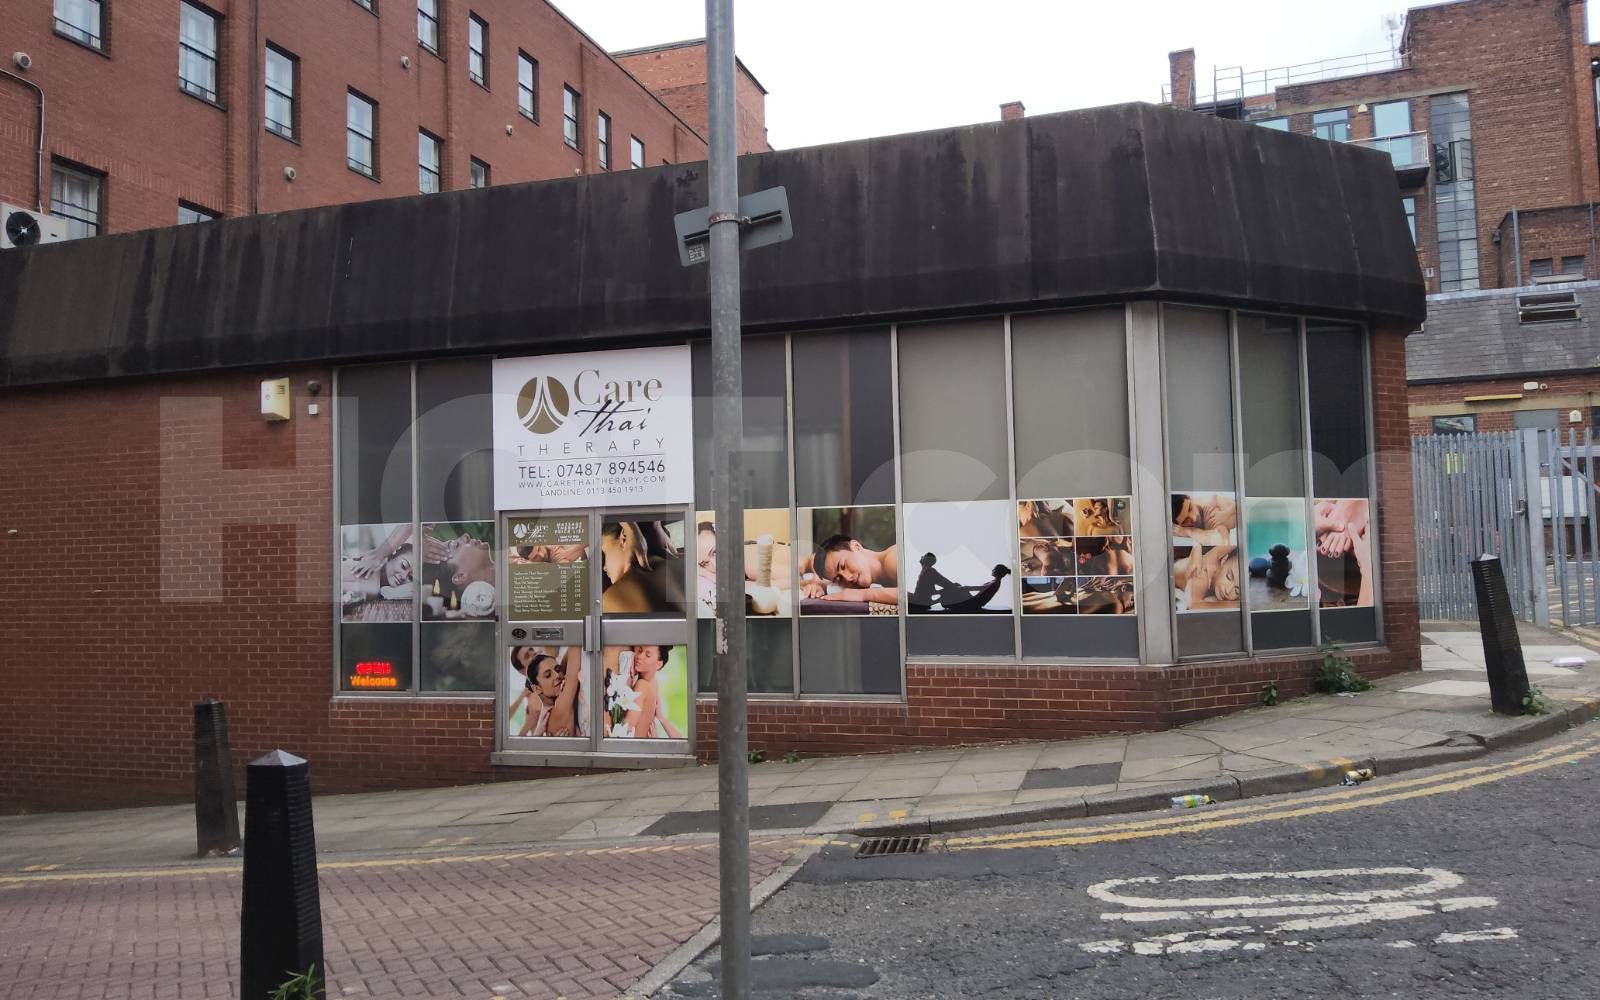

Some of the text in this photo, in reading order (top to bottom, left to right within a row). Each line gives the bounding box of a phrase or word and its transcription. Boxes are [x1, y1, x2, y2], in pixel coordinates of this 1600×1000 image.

[574, 369, 662, 405] Care
[518, 437, 664, 457] THERAPY
[518, 460, 665, 479] TEL: 07487 894546
[608, 486, 622, 494] 450
[625, 485, 644, 493] 1913
[350, 675, 397, 686] Welcome
